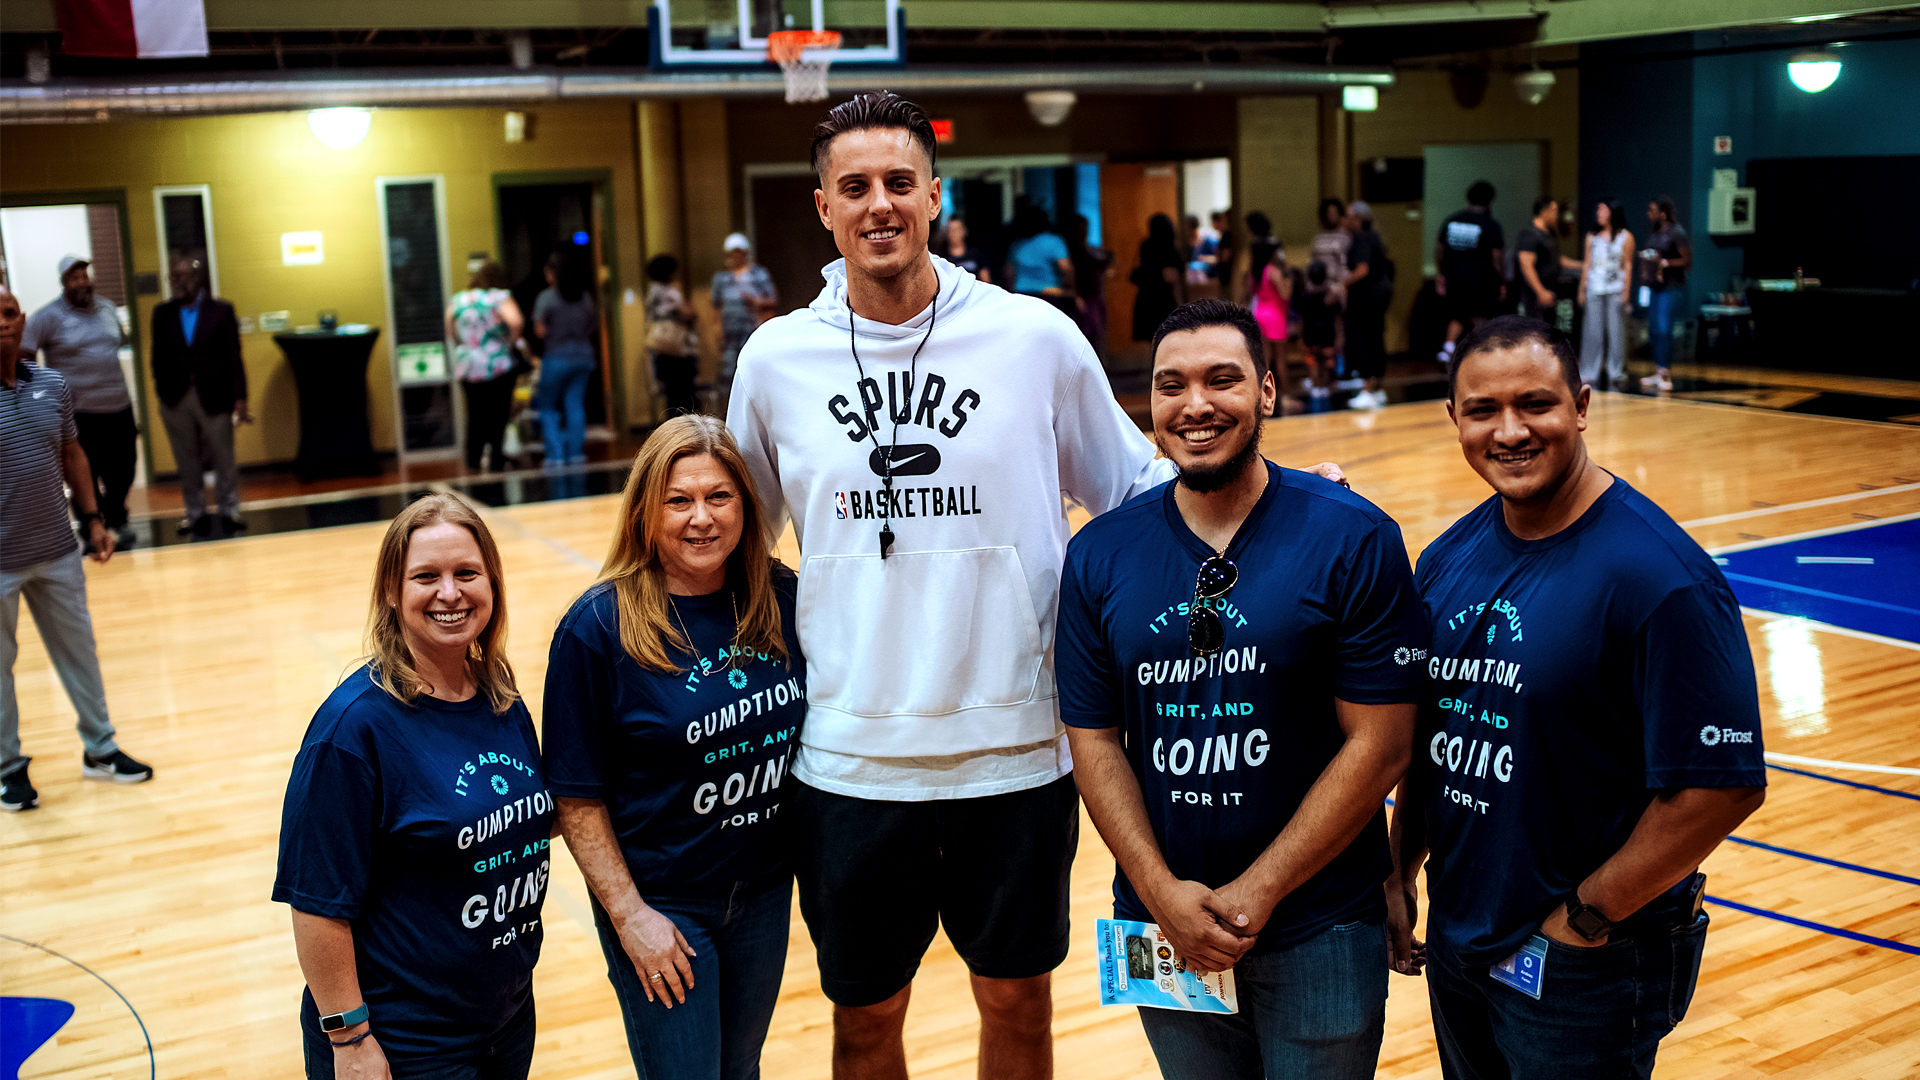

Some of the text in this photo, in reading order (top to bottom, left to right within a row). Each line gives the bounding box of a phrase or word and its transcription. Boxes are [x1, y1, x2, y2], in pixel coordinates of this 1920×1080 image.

[828, 371, 981, 443] SPURS
[850, 485, 981, 519] BASKETBALL
[1150, 602, 1190, 634] IT'S
[1449, 598, 1523, 643] IT'S ABOUT
[685, 657, 713, 693] IT'S
[1138, 646, 1267, 685] GUMPTION,
[686, 677, 804, 744] GUMPTION,
[1156, 702, 1254, 720] GRIT, AND
[704, 741, 754, 764] GRIT,
[1152, 728, 1271, 776] GOING
[1722, 728, 1753, 744] Frost
[455, 751, 535, 796] IT'S ABOUT
[1430, 731, 1514, 783] GOING
[693, 744, 792, 815] GOIN
[1444, 785, 1473, 808] FOR
[1171, 790, 1243, 806] FOR IT
[720, 804, 779, 830] FOR IT
[473, 838, 550, 873] GRIT, AND
[461, 859, 550, 929] GOING
[492, 920, 539, 950] FOR IT
[1105, 944, 1113, 963] Thank
[1106, 965, 1115, 994] SPECIAL
